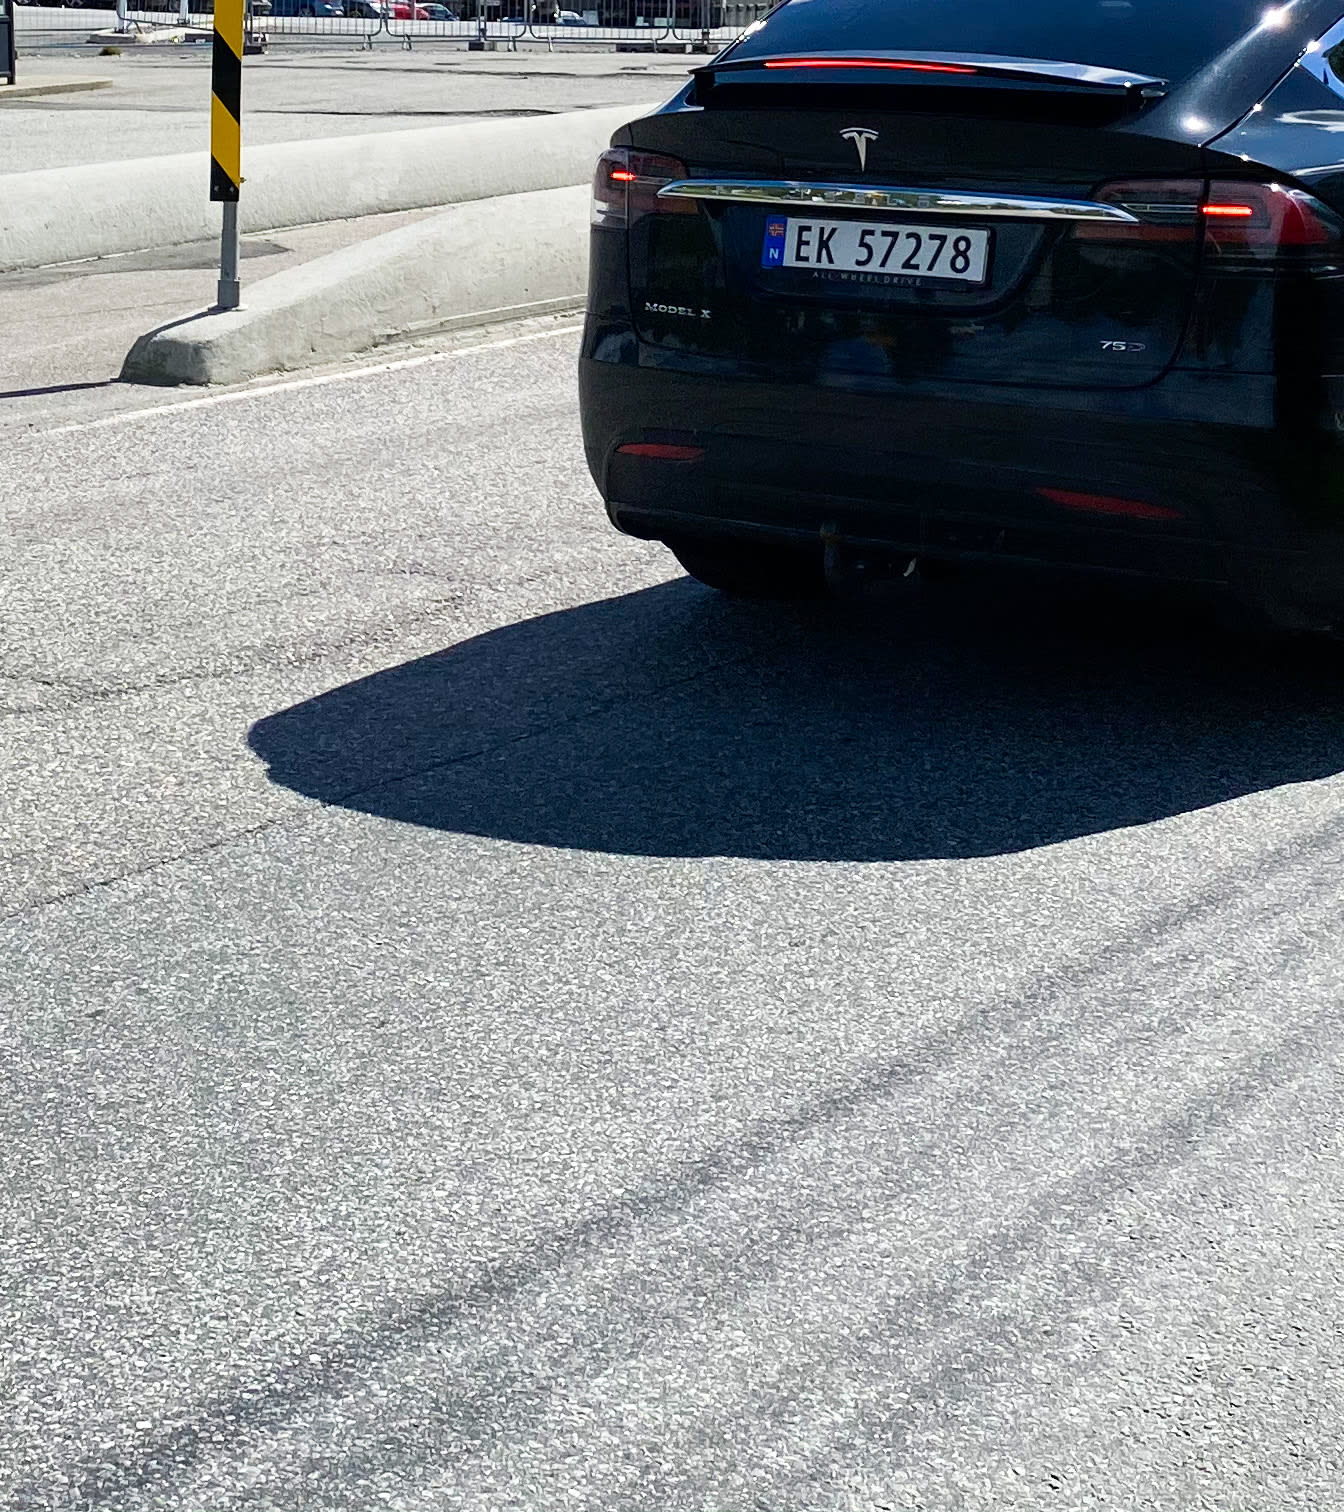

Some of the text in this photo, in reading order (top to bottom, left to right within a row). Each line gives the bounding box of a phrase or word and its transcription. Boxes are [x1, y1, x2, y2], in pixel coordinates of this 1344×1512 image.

[769, 248, 779, 259] N
[795, 225, 972, 274] EK 57278
[644, 302, 712, 319] MODEL X
[1099, 340, 1146, 352] 75D
